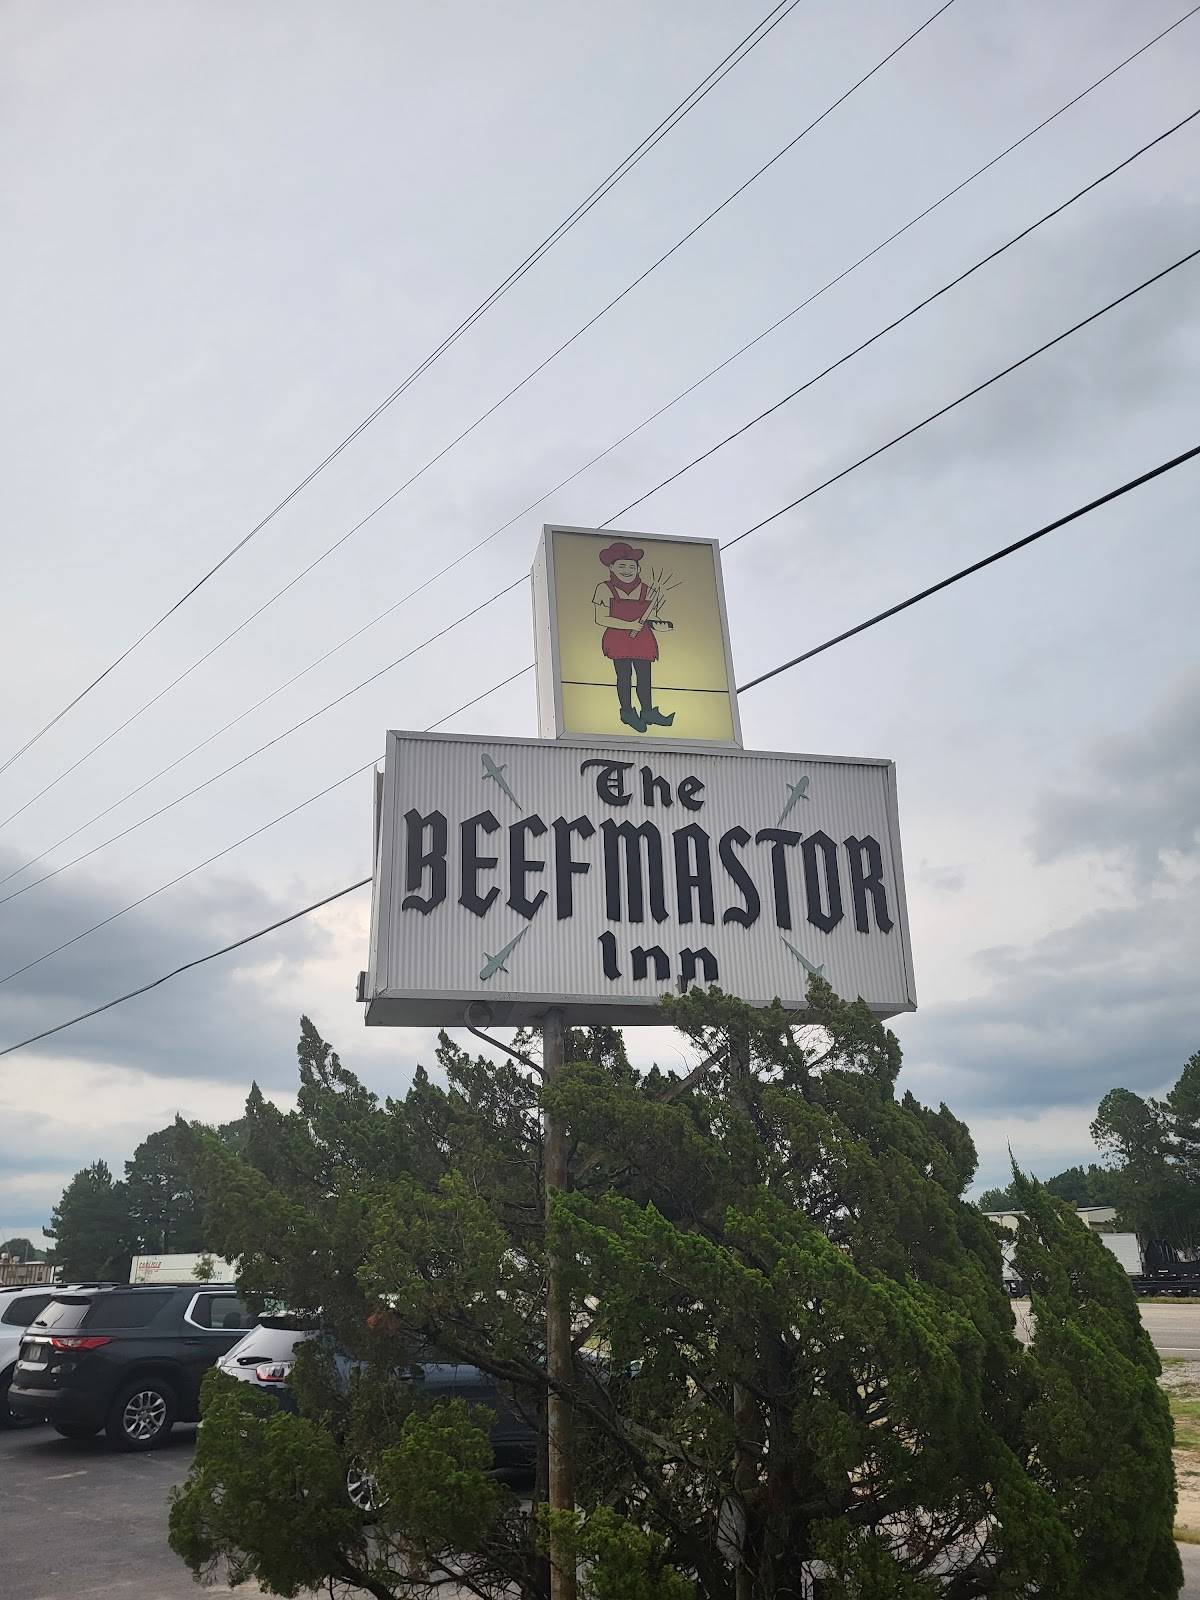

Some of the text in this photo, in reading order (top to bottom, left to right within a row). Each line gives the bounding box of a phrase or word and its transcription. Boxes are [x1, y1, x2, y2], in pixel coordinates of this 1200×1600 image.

[580, 758, 706, 811] The
[402, 807, 894, 934] BEEFMASTOR
[598, 930, 719, 981] Inn
